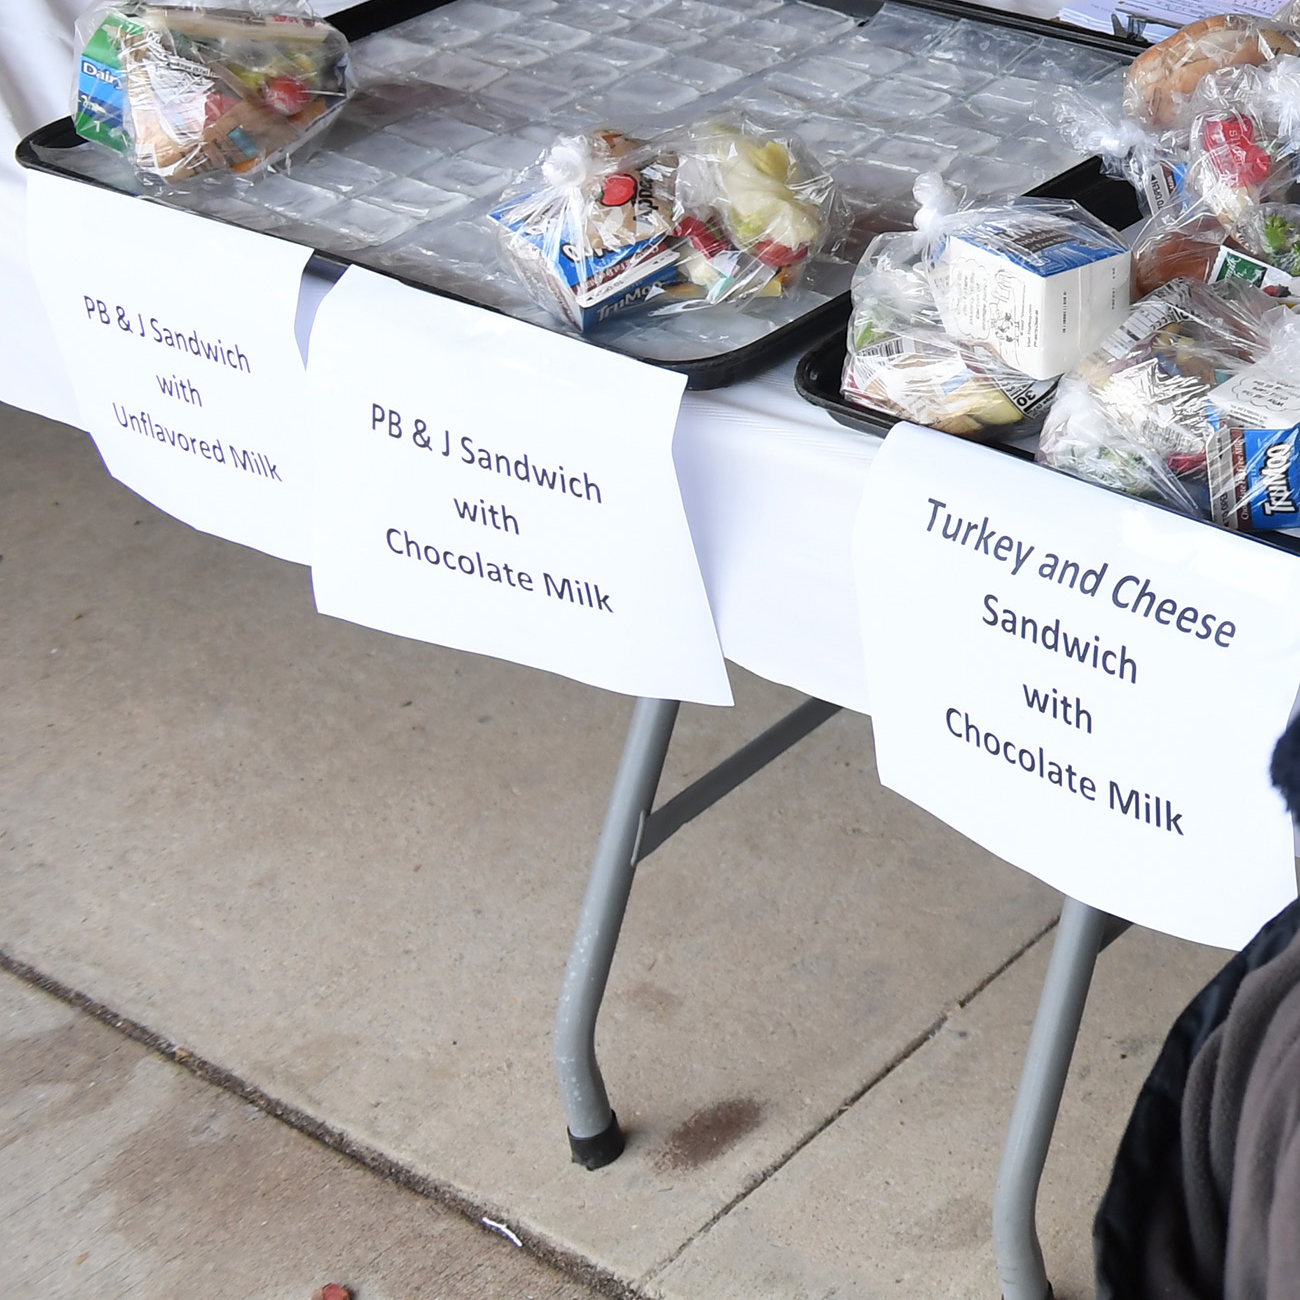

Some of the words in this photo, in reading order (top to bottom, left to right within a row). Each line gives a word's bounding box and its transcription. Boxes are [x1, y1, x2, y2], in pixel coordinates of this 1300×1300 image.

[82, 61, 123, 90] Dairy
[84, 295, 110, 325] PB
[116, 306, 133, 333] &
[138, 314, 145, 337] J
[150, 318, 251, 373] Sandwich
[156, 375, 202, 407] with
[113, 402, 226, 464] Unflavored
[229, 445, 283, 482] Milk
[372, 403, 402, 438] PB
[413, 418, 433, 451] &
[442, 430, 450, 457] J
[461, 436, 602, 504] Sandwich
[1260, 442, 1299, 516] TruMoo
[453, 498, 520, 535] with
[386, 528, 534, 591] Chocolate
[543, 572, 614, 613] Milk
[925, 497, 1034, 576] Turkey
[1039, 551, 1109, 597] and
[1112, 575, 1237, 648] Cheese
[982, 594, 1138, 684] Sandwich
[1022, 682, 1093, 734] with
[945, 707, 1097, 802] Chocolate
[1109, 781, 1185, 836] Milk
